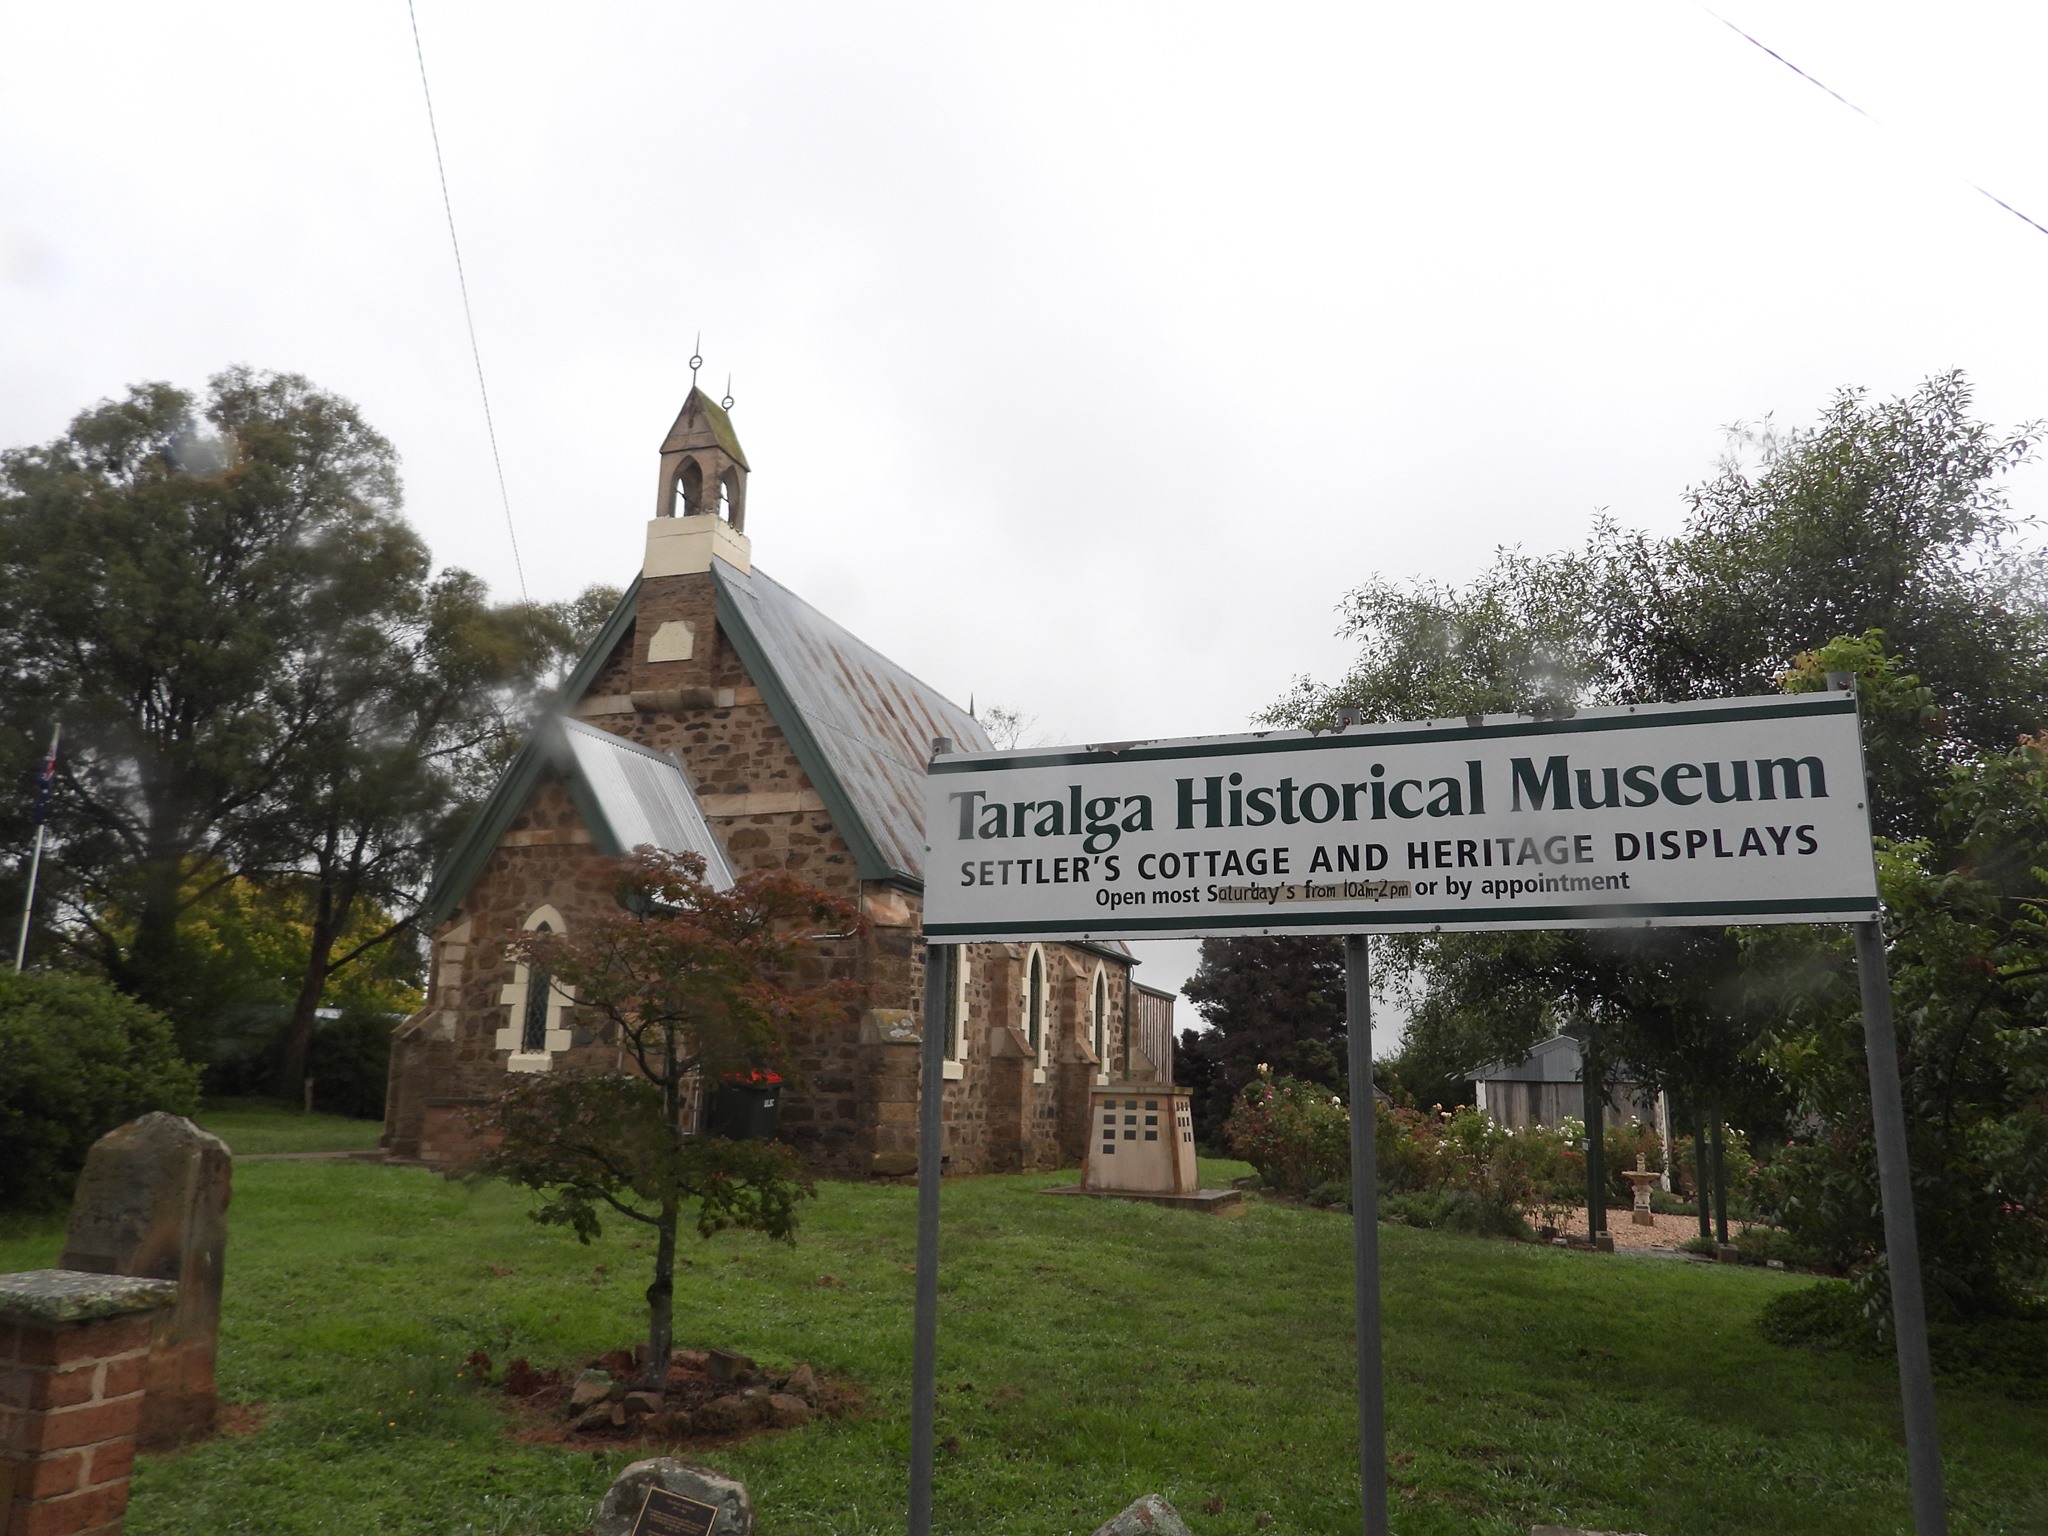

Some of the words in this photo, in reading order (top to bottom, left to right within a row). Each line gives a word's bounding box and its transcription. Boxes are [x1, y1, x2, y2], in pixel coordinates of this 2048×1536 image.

[949, 785, 1154, 855] Taralga
[1175, 760, 1486, 830] Historical
[1509, 755, 1829, 813] Museum
[960, 854, 1121, 887] SETTLER'S
[1138, 846, 1291, 880] COTTAGE
[1309, 843, 1389, 873] AND
[1407, 834, 1594, 869] HERITAGE
[1615, 824, 1819, 861] DISPLAYS
[1096, 888, 1146, 910] Open
[1152, 886, 1201, 905] most
[1207, 881, 1295, 905] Saturday's
[1305, 879, 1336, 898] from
[1415, 878, 1438, 896] or
[1446, 874, 1471, 900] by
[1481, 871, 1630, 899] appointment
